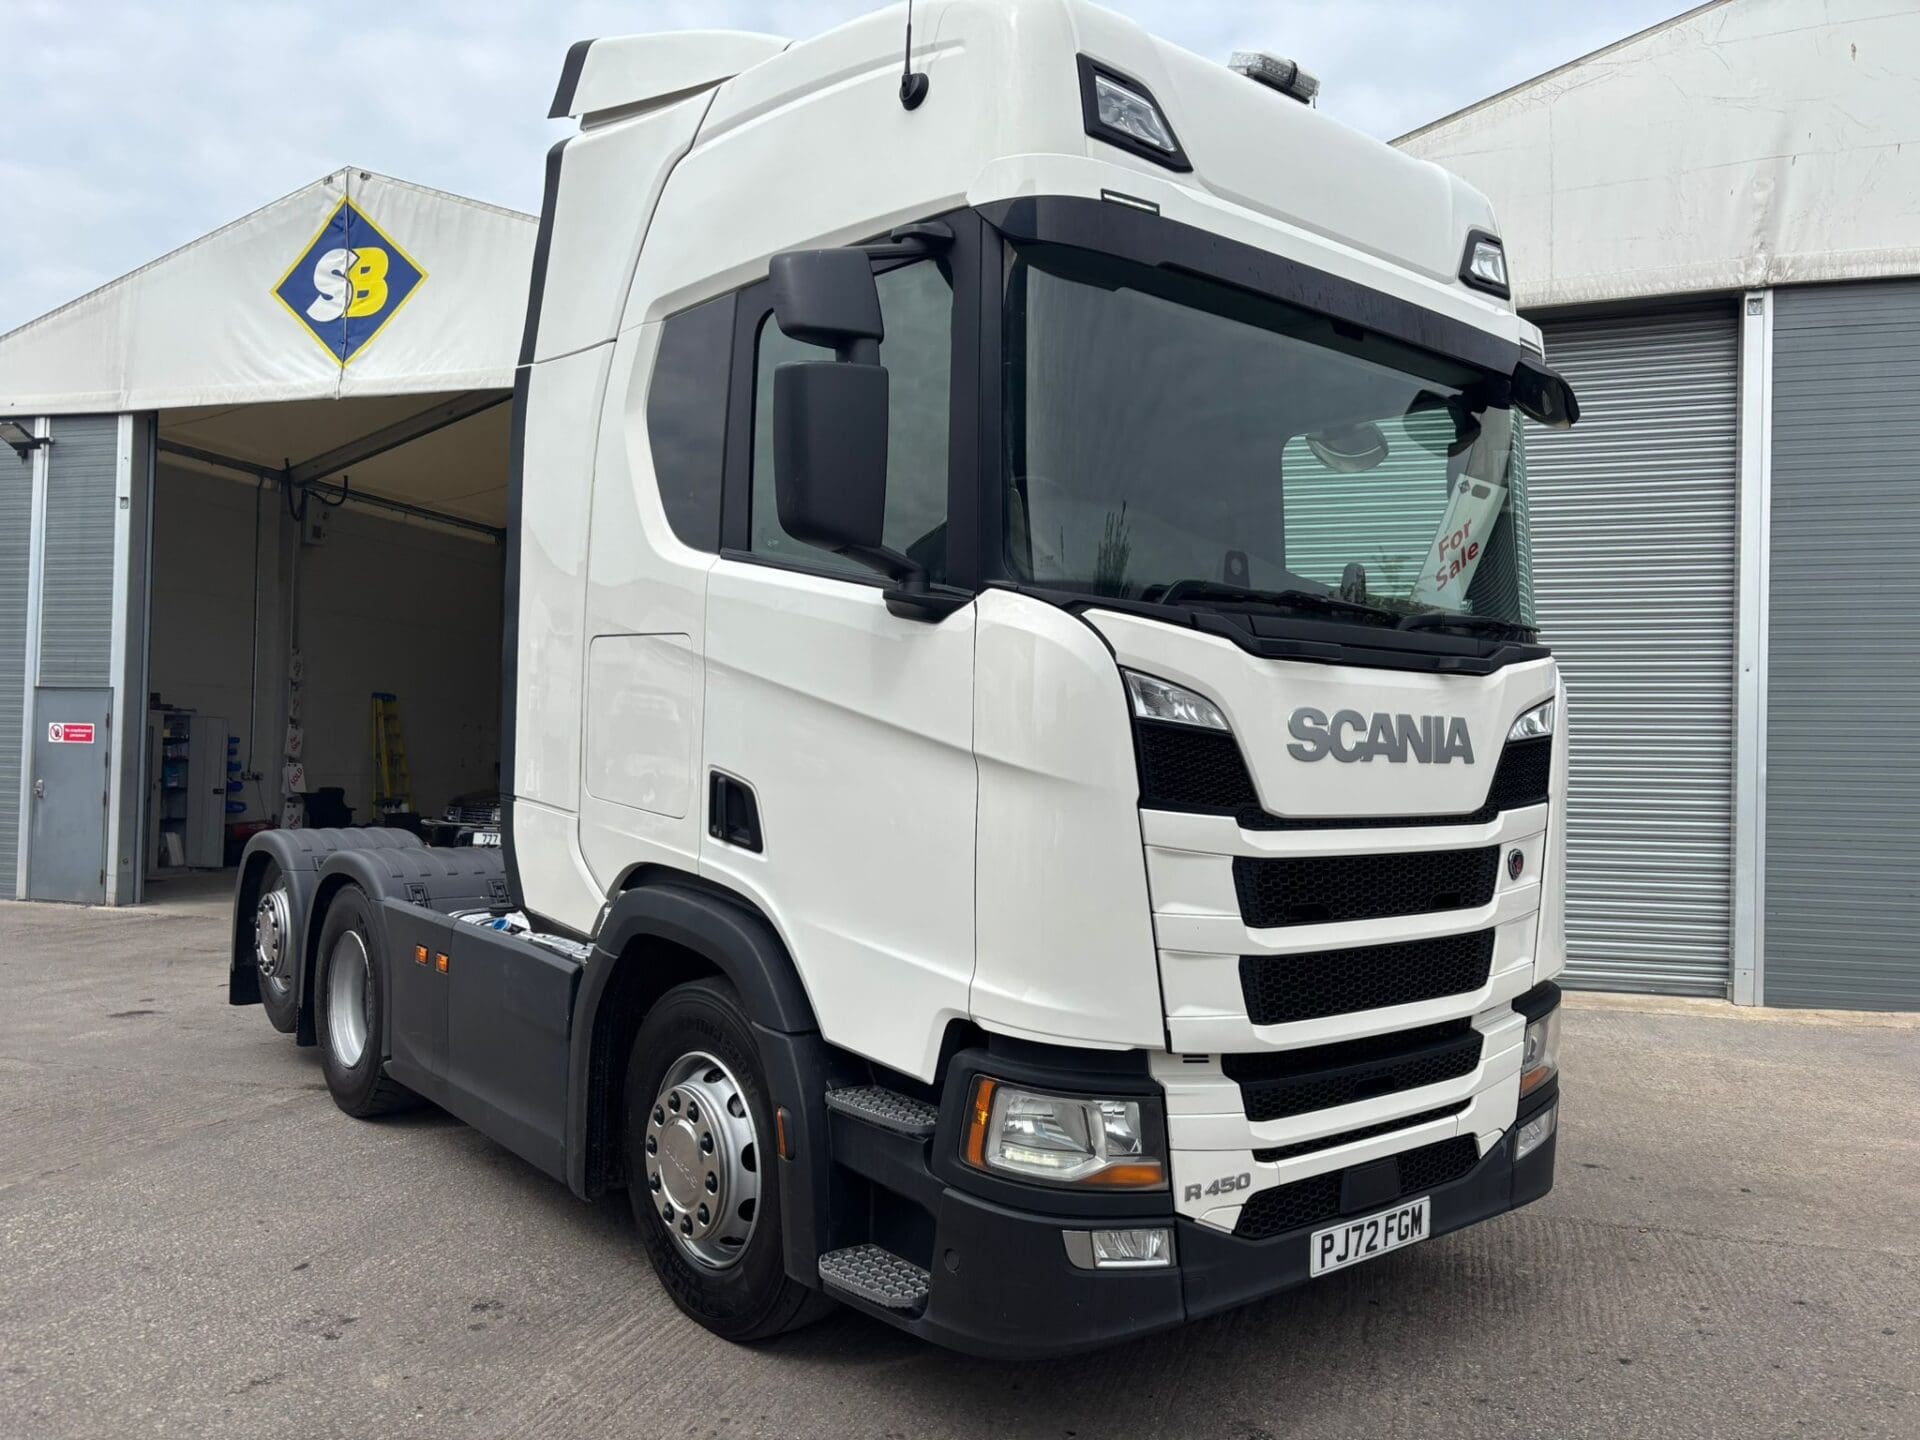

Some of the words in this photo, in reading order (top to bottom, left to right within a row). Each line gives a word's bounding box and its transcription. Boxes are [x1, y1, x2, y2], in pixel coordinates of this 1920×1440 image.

[306, 247, 390, 322] SB
[1436, 541, 1479, 591] Sale
[1438, 518, 1472, 562] For
[1286, 707, 1476, 764] SCANIA
[1184, 1183, 1202, 1202] R
[1205, 1173, 1251, 1197] 450
[1320, 1220, 1379, 1269] PJ72
[1384, 1203, 1423, 1247] FGM
